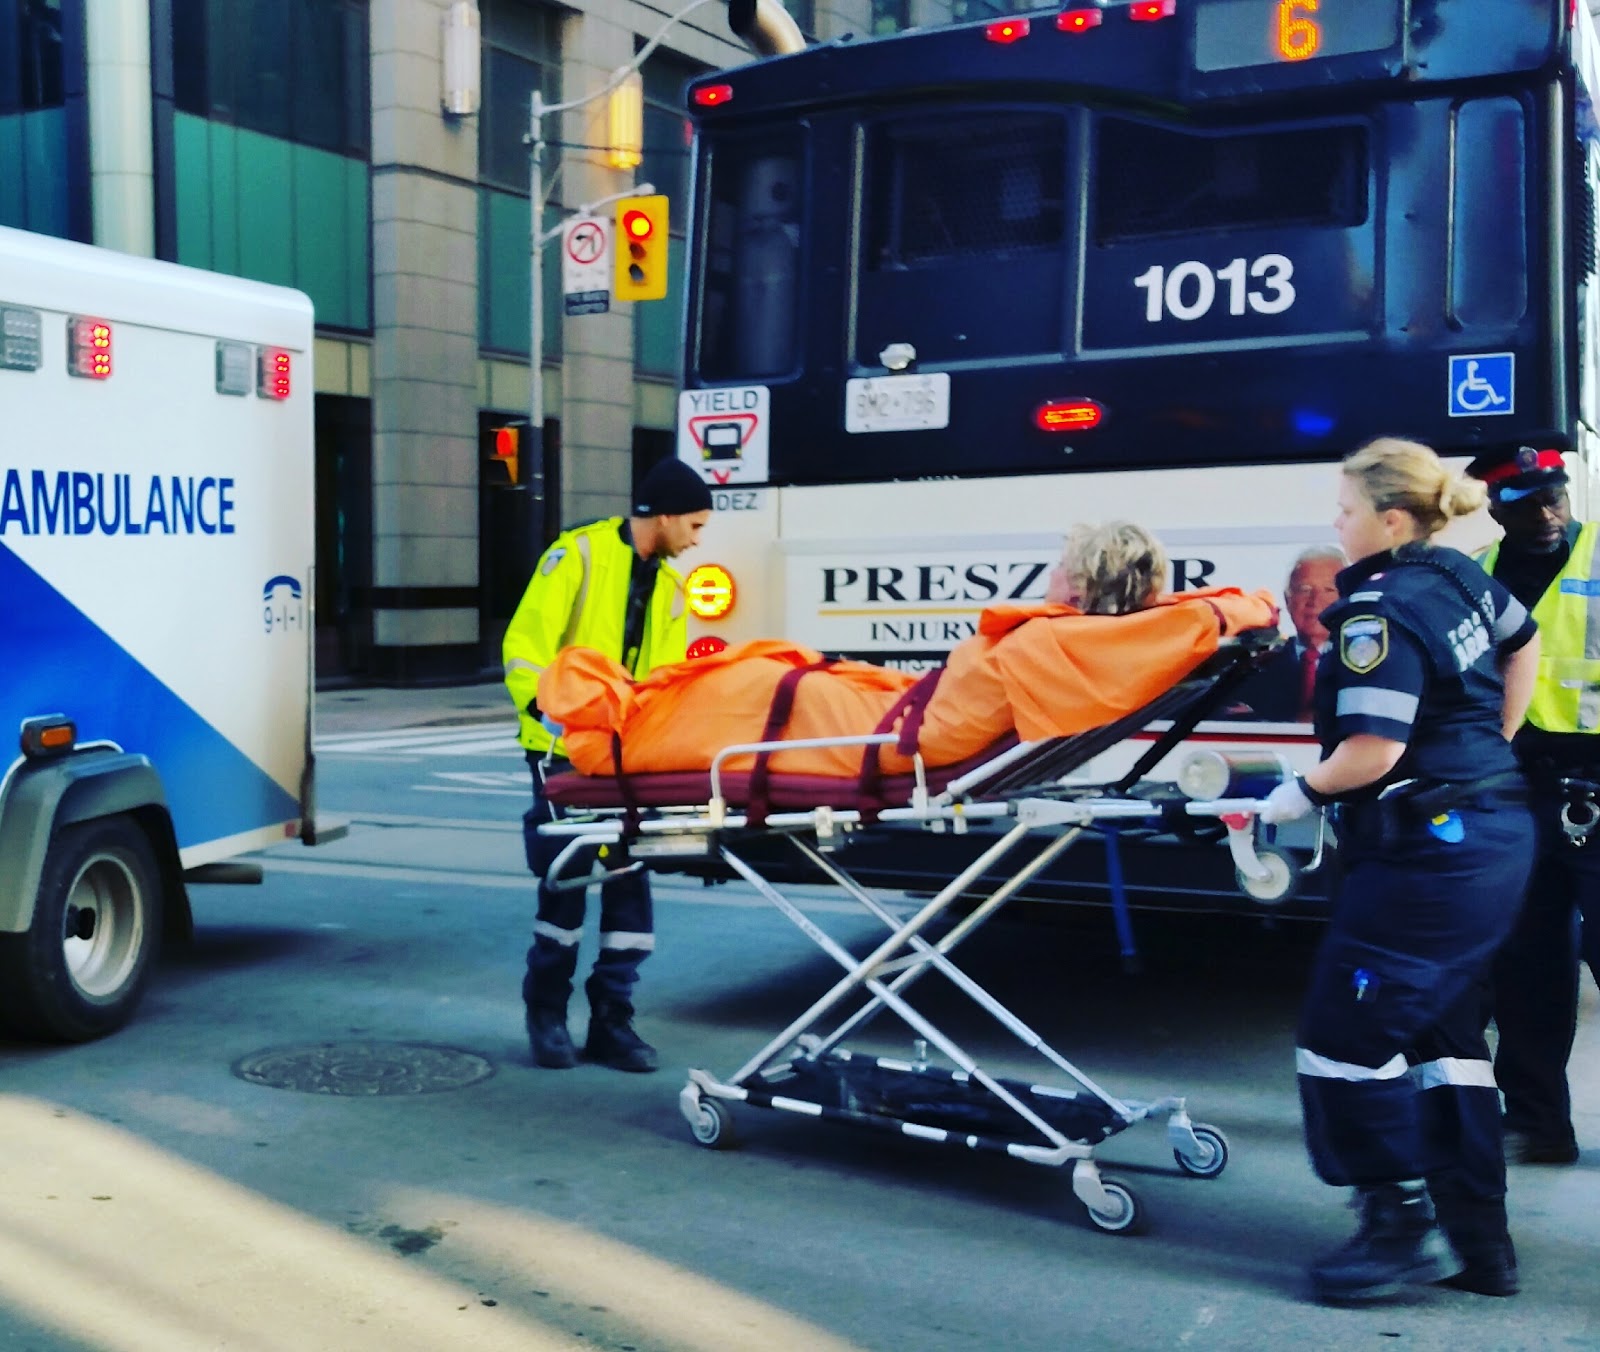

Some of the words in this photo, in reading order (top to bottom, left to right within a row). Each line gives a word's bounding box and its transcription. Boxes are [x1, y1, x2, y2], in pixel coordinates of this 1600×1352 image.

[1279, 0, 1318, 60] 6
[1134, 253, 1297, 323] 1013
[689, 389, 759, 413] YIELD
[0, 469, 236, 536] AMBULANCE
[710, 492, 758, 512] DEZ
